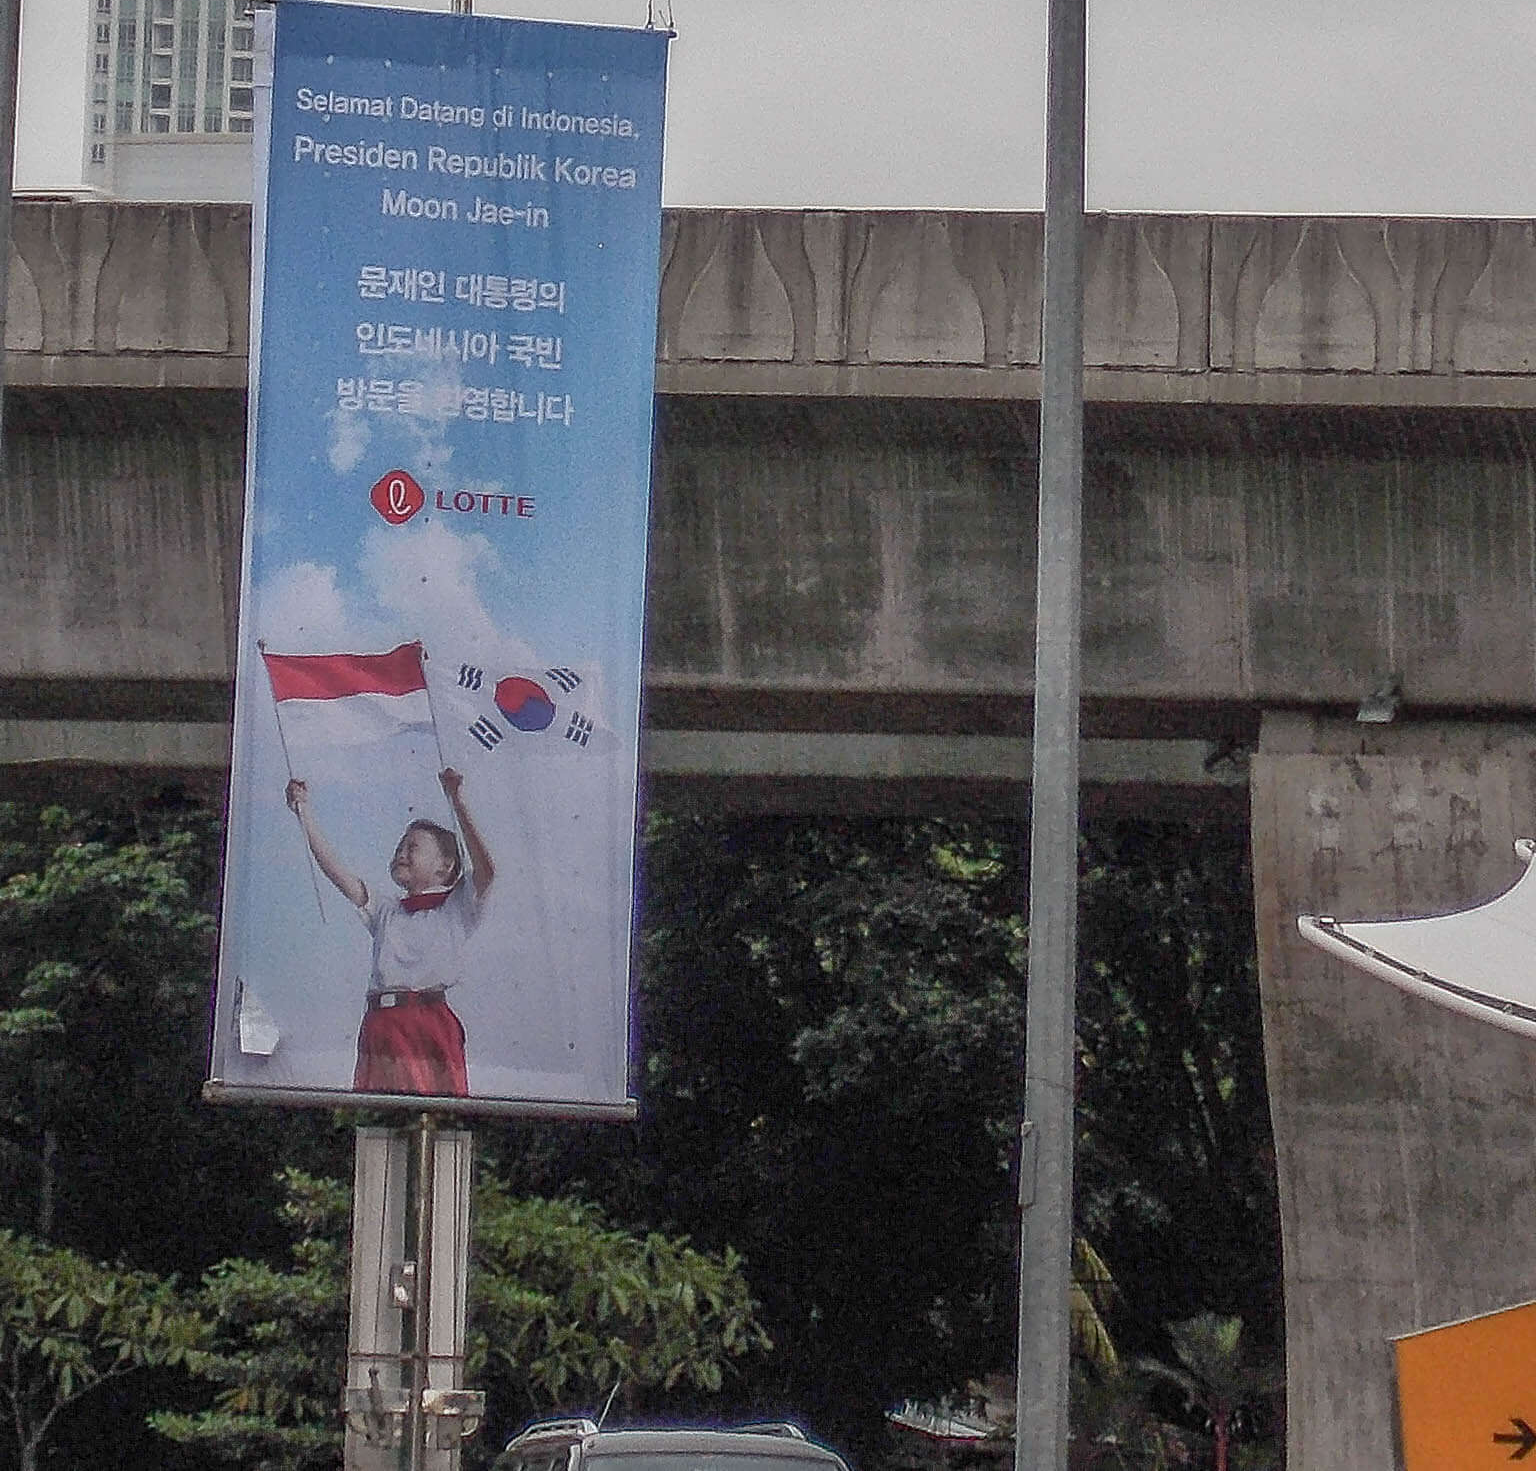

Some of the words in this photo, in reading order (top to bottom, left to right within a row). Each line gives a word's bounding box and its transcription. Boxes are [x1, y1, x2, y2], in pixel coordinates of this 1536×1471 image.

[296, 88, 392, 117] Selamat
[401, 97, 485, 128] Datang
[494, 107, 513, 127] di
[293, 136, 417, 170] Presiden
[428, 145, 546, 182] Republik
[555, 157, 636, 188] Korea
[381, 191, 458, 219] Moon
[466, 198, 549, 228] Jae-in
[357, 266, 446, 304] 문재인
[455, 275, 566, 313] 대통령의
[508, 335, 561, 370] 국빈
[435, 491, 535, 517] LOTTE
